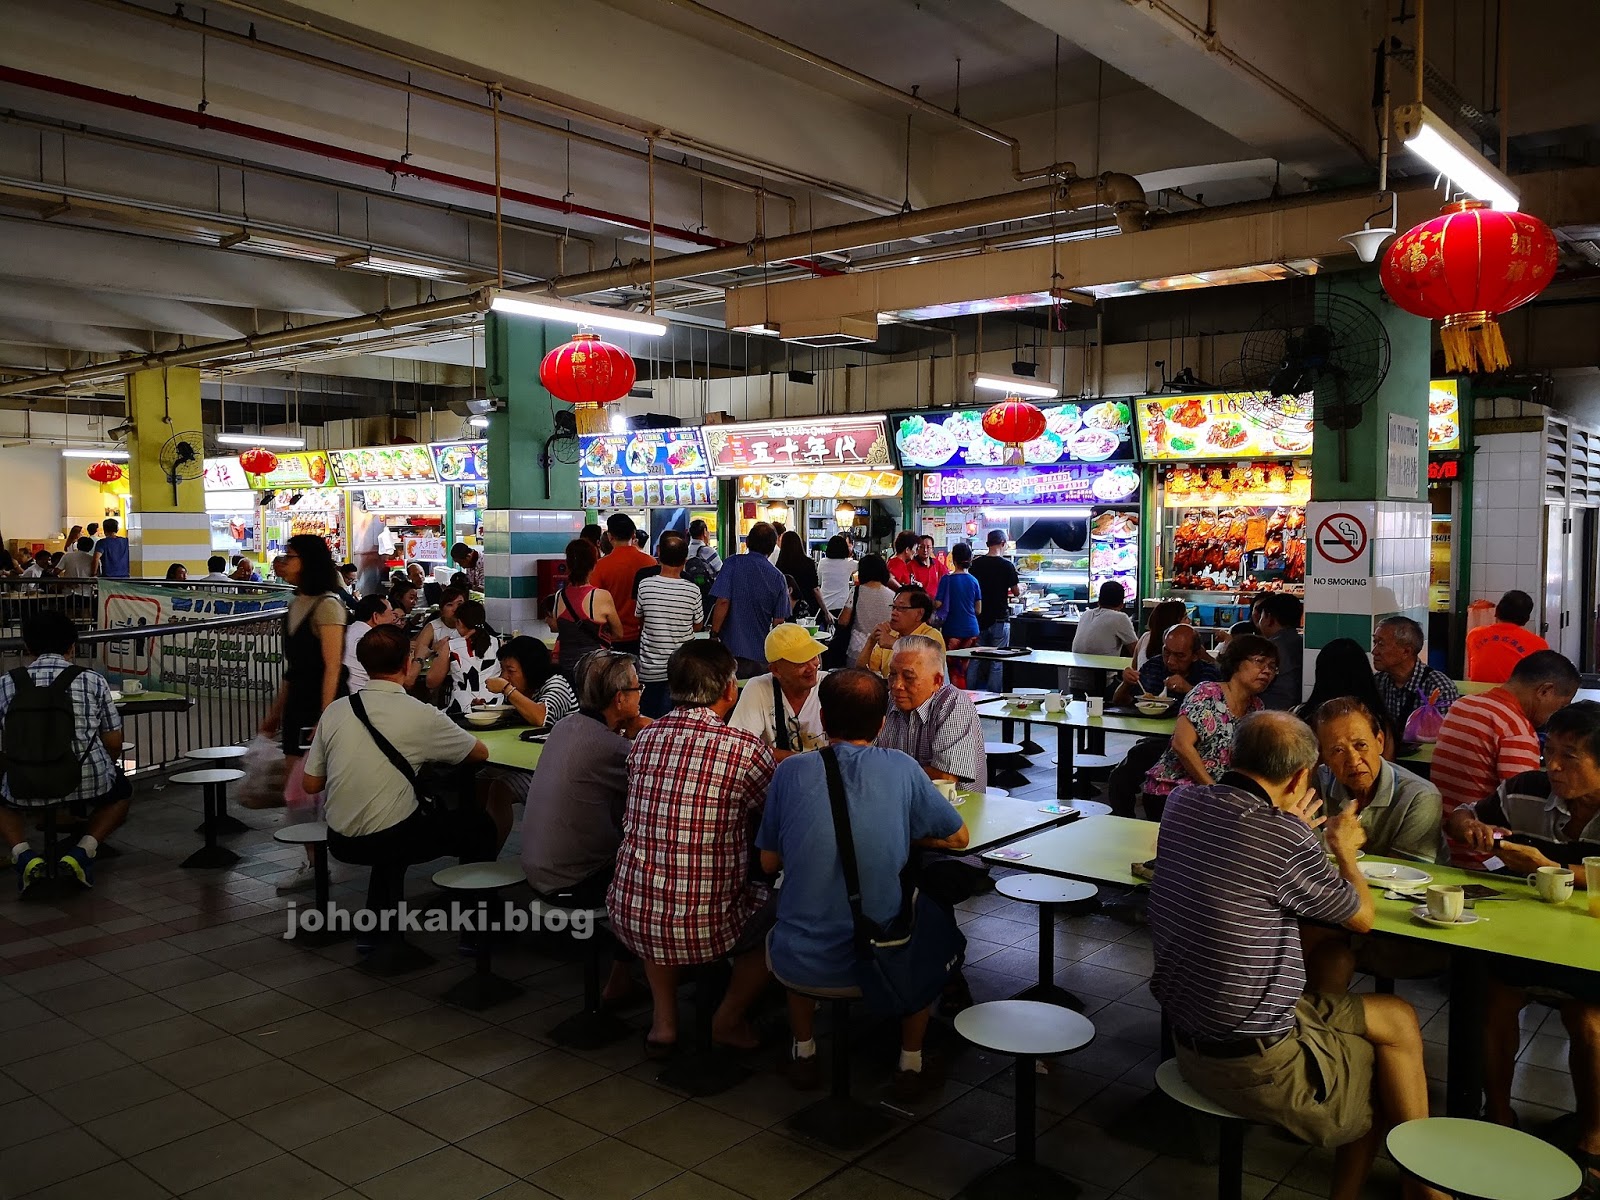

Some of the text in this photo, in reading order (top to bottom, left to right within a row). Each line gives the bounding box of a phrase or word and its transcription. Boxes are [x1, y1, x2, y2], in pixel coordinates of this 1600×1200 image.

[749, 434, 866, 467] 五十年代
[1313, 577, 1367, 586] NO SMOKING
